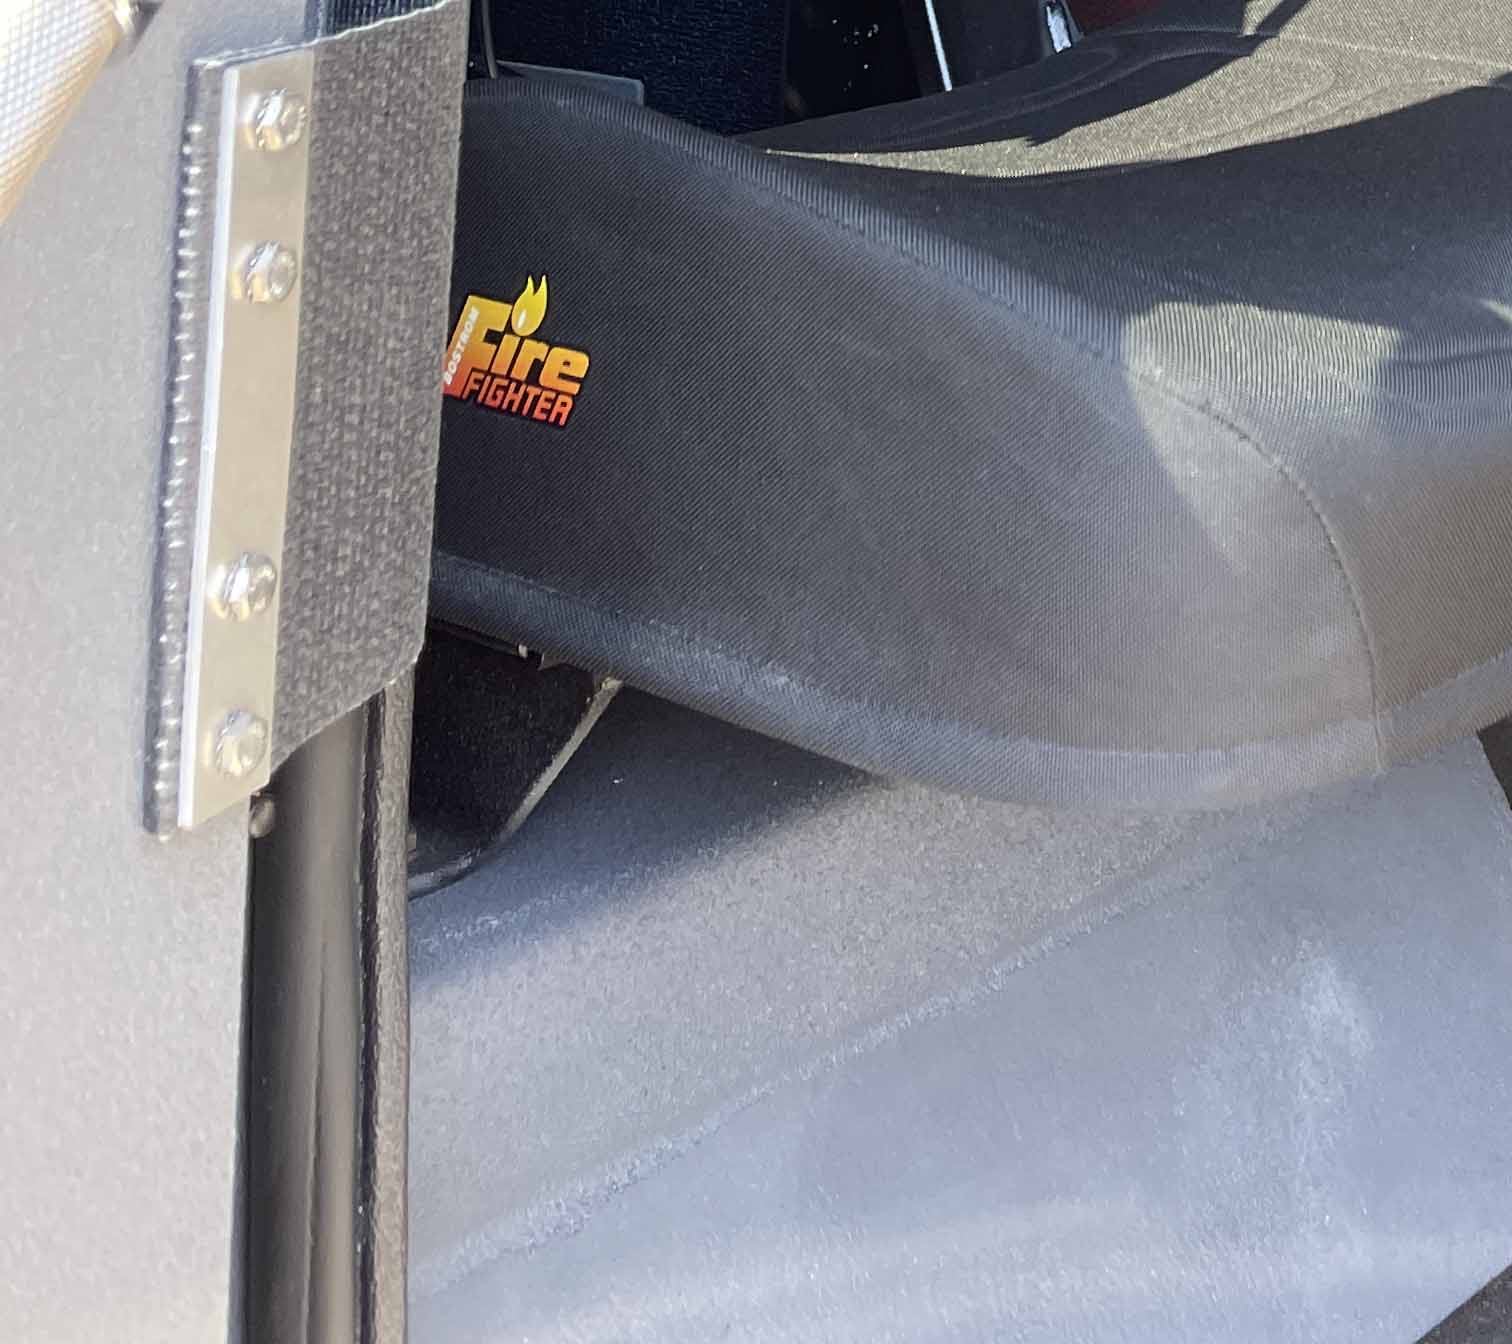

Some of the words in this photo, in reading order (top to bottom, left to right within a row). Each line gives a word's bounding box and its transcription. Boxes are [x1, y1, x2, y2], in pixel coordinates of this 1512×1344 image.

[443, 274, 590, 398] Fire
[443, 305, 480, 385] BOSTROM
[462, 369, 574, 427] FIGHTER
